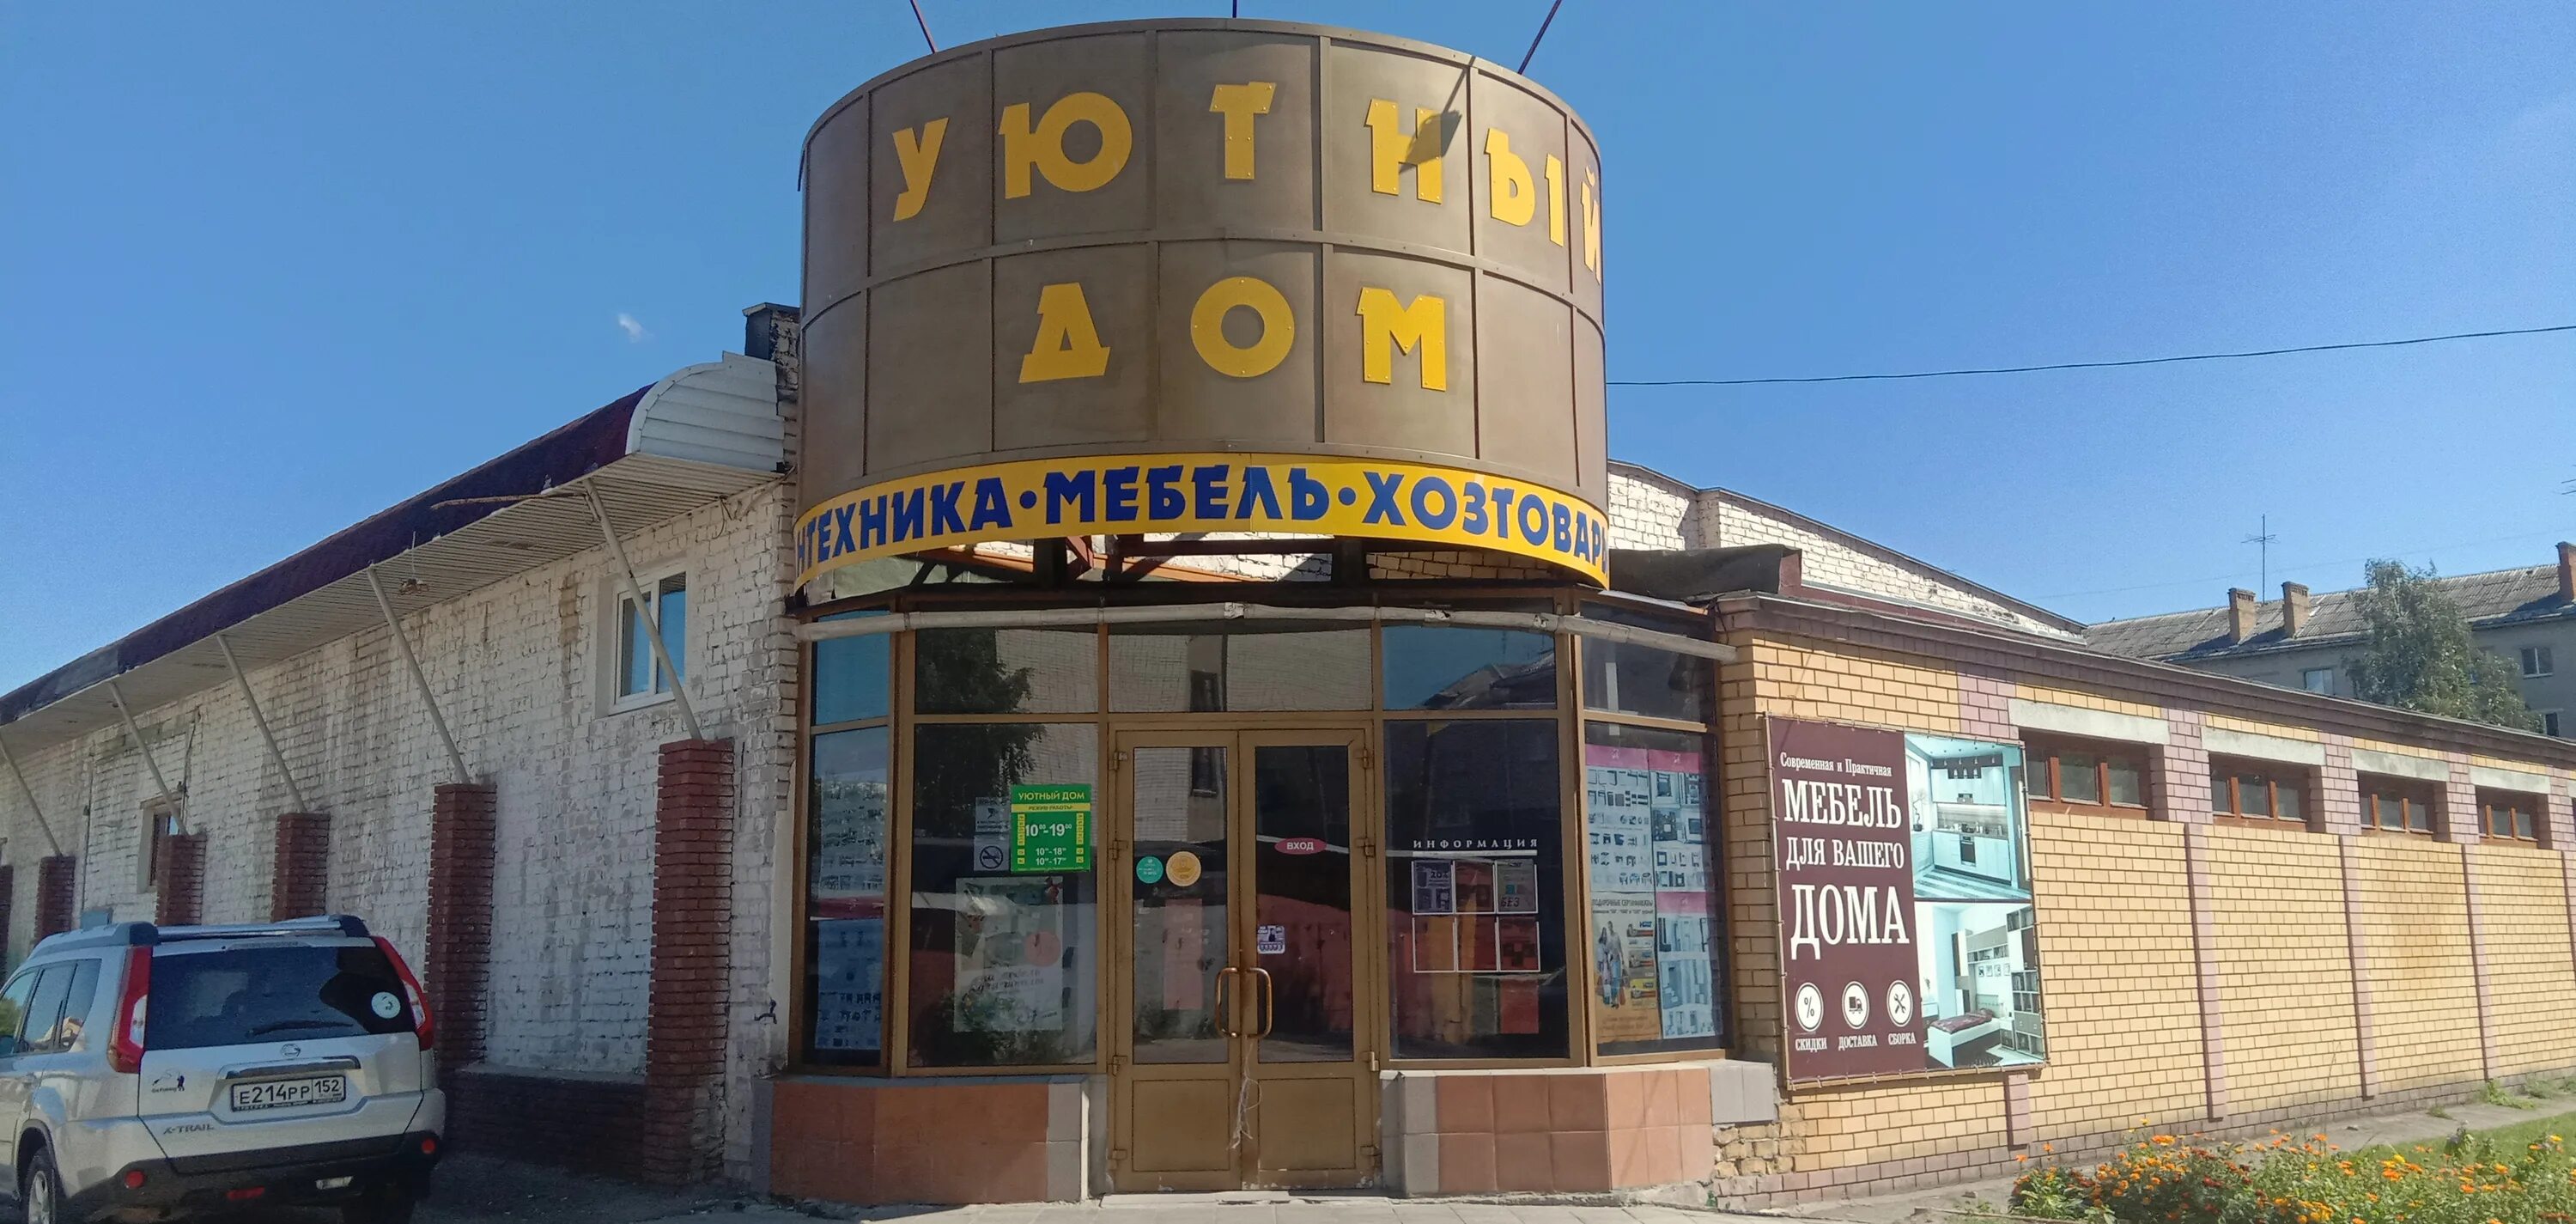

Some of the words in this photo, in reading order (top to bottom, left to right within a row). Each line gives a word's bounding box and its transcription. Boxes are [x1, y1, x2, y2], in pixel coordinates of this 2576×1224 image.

[891, 82, 1601, 286] УЮТНЫЙ
[1018, 277, 1446, 392] ДОМ
[1041, 464, 1331, 523] МЕБЕЛЬ
[1780, 752, 1834, 771] Современная
[1837, 761, 1844, 773] и
[1845, 758, 1892, 776] Практичная
[1018, 791, 1060, 801] УЮТНЫЙ
[1062, 791, 1084, 801] ДОМ
[1782, 779, 1902, 829] МЕБЕЛЬ
[1286, 842, 1314, 851] ВХОД
[1413, 839, 1537, 849] ИНФОРМАЦИЯ
[1786, 837, 1826, 871] ДЛЯ
[1832, 839, 1905, 869] ВАШЕГО
[1790, 884, 1910, 960] ДОМА
[1795, 1038, 1827, 1052] СКИДКИ
[1838, 1034, 1878, 1050] ДОСТАВКА
[1888, 1032, 1917, 1045] СБОРКА
[314, 1079, 339, 1093] 152
[163, 1124, 214, 1135] X-TRAIL
